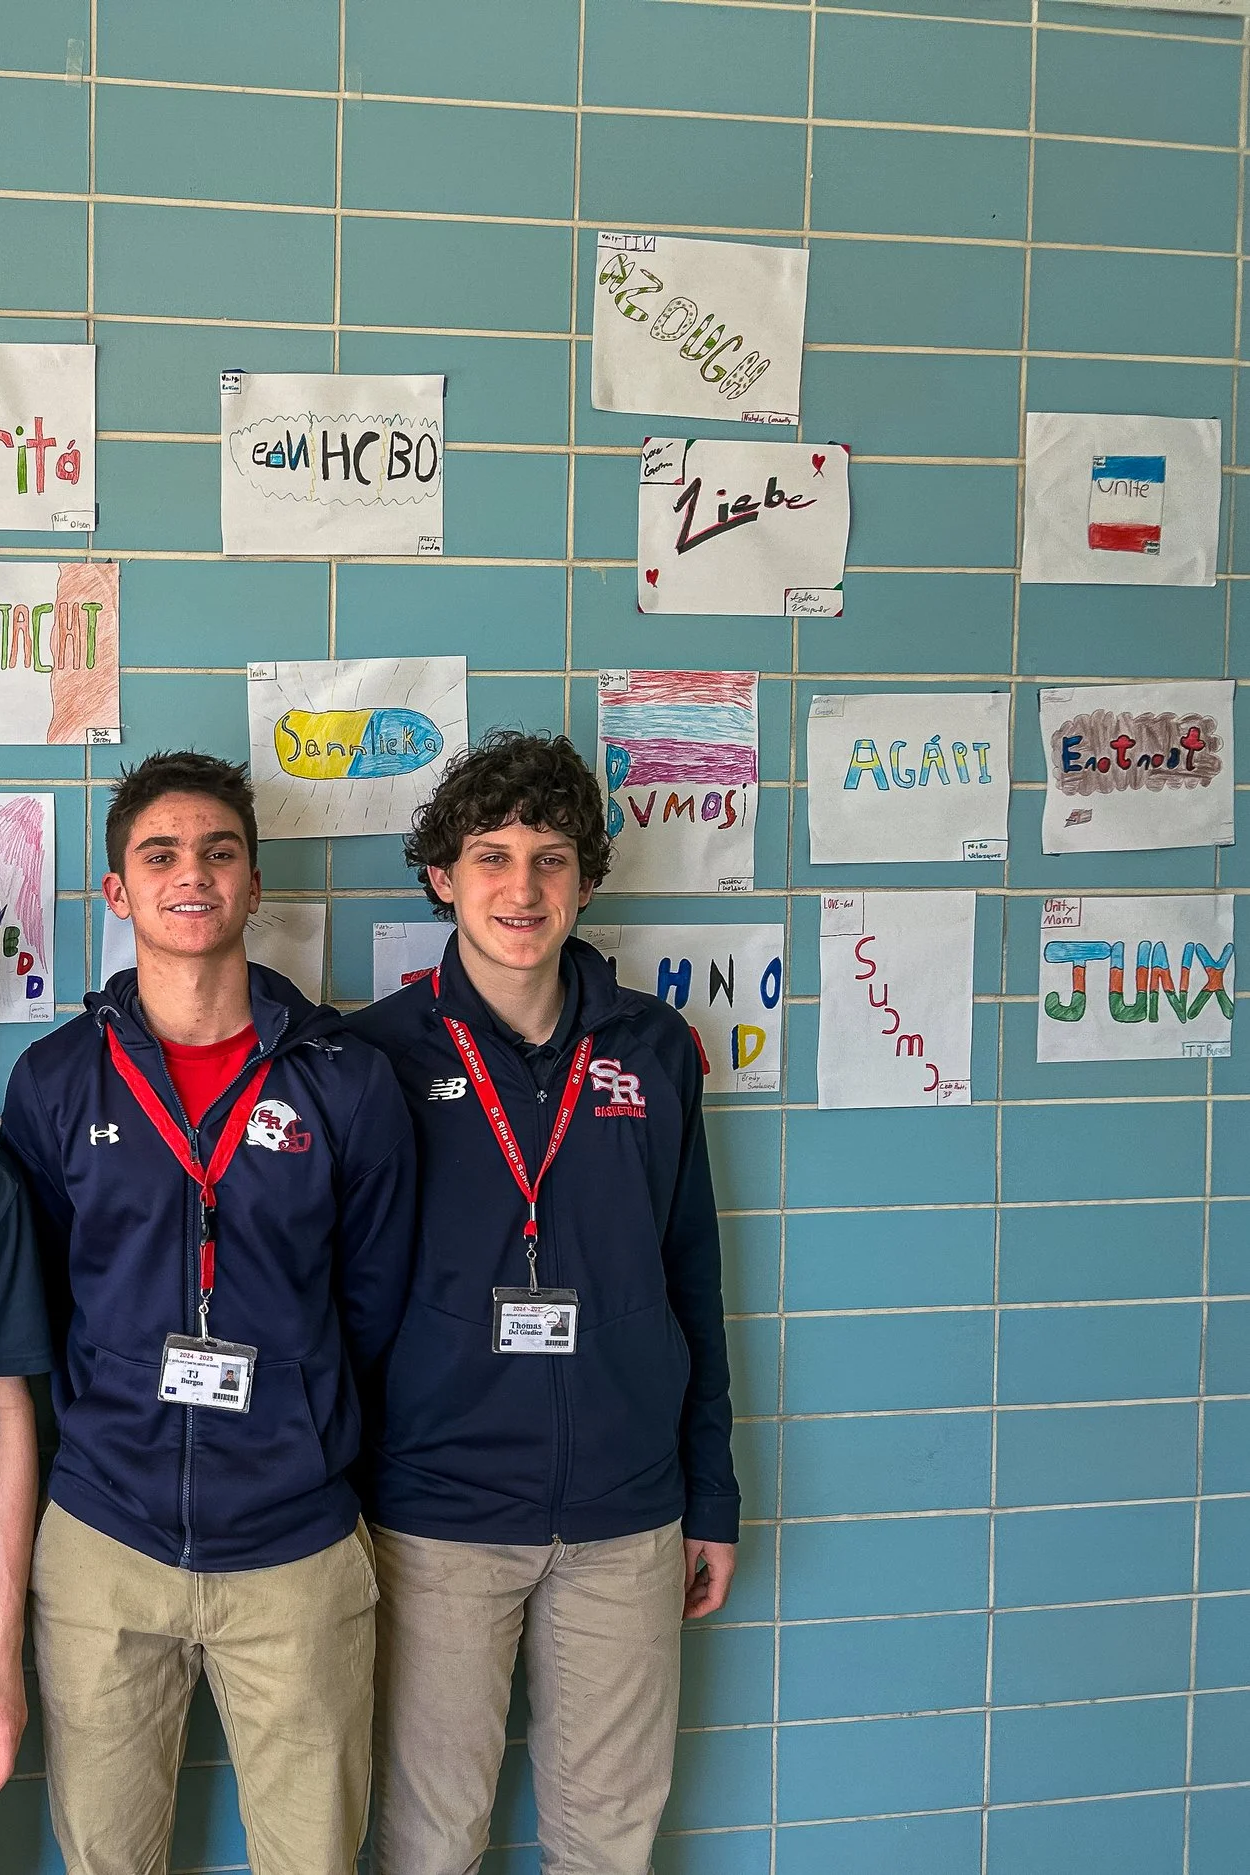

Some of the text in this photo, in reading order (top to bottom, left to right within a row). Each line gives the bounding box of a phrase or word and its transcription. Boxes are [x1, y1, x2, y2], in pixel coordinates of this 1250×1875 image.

[672, 476, 818, 554] Liebe
[1044, 940, 1235, 1022] JUNX
[456, 1027, 471, 1051] High
[465, 1050, 486, 1083] School
[571, 1073, 581, 1085] St.
[554, 1107, 570, 1140] School
[490, 1106, 532, 1192] St. Rita High Schoo
[510, 1321, 542, 1330] Thomas
[179, 1351, 214, 1362] 2024 2025
[180, 1377, 204, 1387] Burgos
[186, 1369, 200, 1380] TJ
